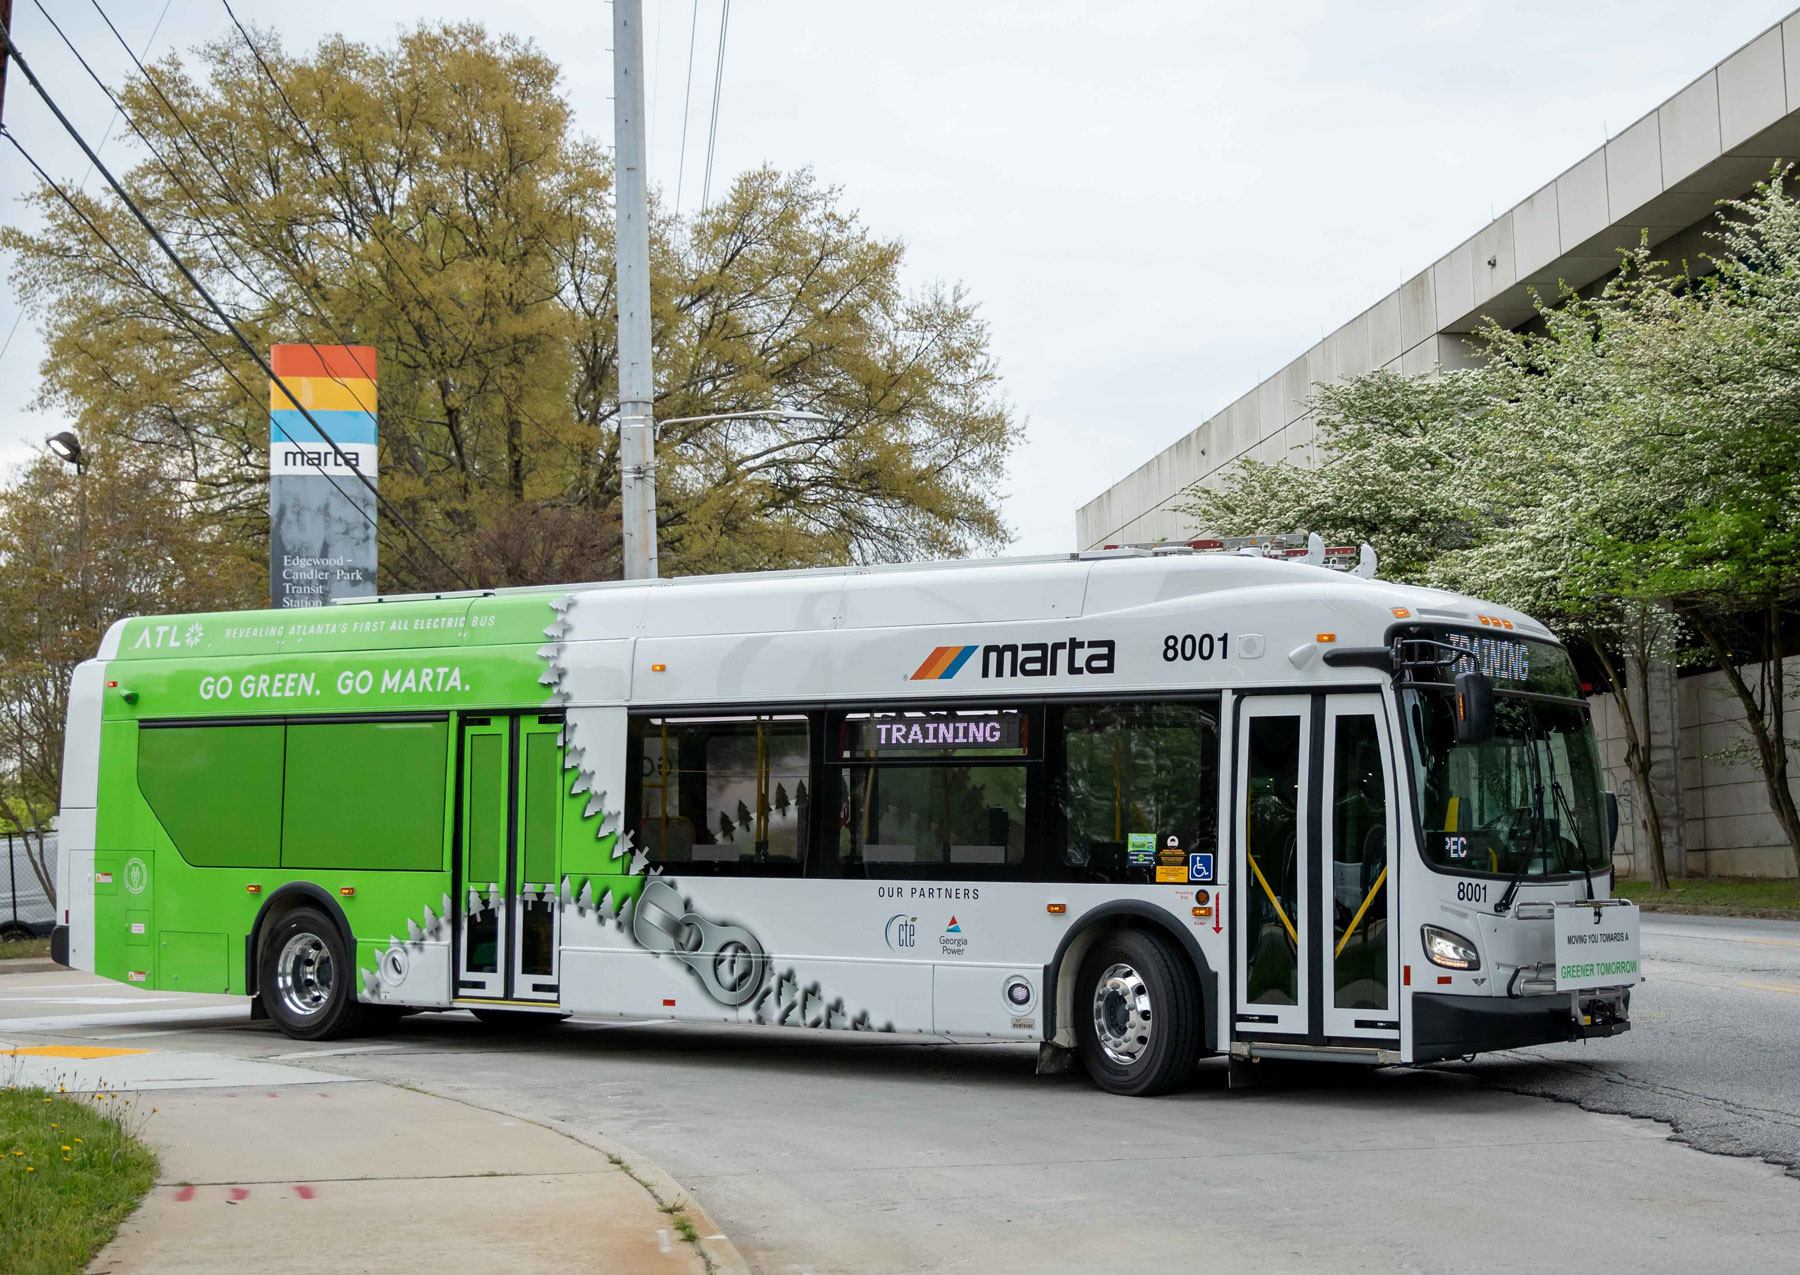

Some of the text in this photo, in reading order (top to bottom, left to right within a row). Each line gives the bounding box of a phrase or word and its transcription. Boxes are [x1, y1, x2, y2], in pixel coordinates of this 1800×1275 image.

[284, 451, 360, 467] marta
[282, 568, 363, 581] Candler Park
[282, 583, 324, 594] Transit
[282, 597, 323, 608] Station
[225, 615, 496, 639] REVEALING ATLANTA'S FIRST ALL ELECTRIC BUS
[134, 625, 181, 649] ATL
[1162, 632, 1229, 662] 8001
[981, 637, 1115, 679] marta
[1449, 633, 1529, 681] TRAINING
[200, 667, 471, 700] GO GREEN. GO MARTA.
[876, 722, 1001, 745] TRAINING
[878, 886, 980, 900] OUR PARTNERS
[1457, 881, 1487, 903] 8001
[939, 935, 968, 947] Georgia
[1567, 932, 1629, 945] MOVING YOU TOWARDS A
[942, 945, 965, 956] Power
[1561, 960, 1637, 979] GREENER TOMORROW
